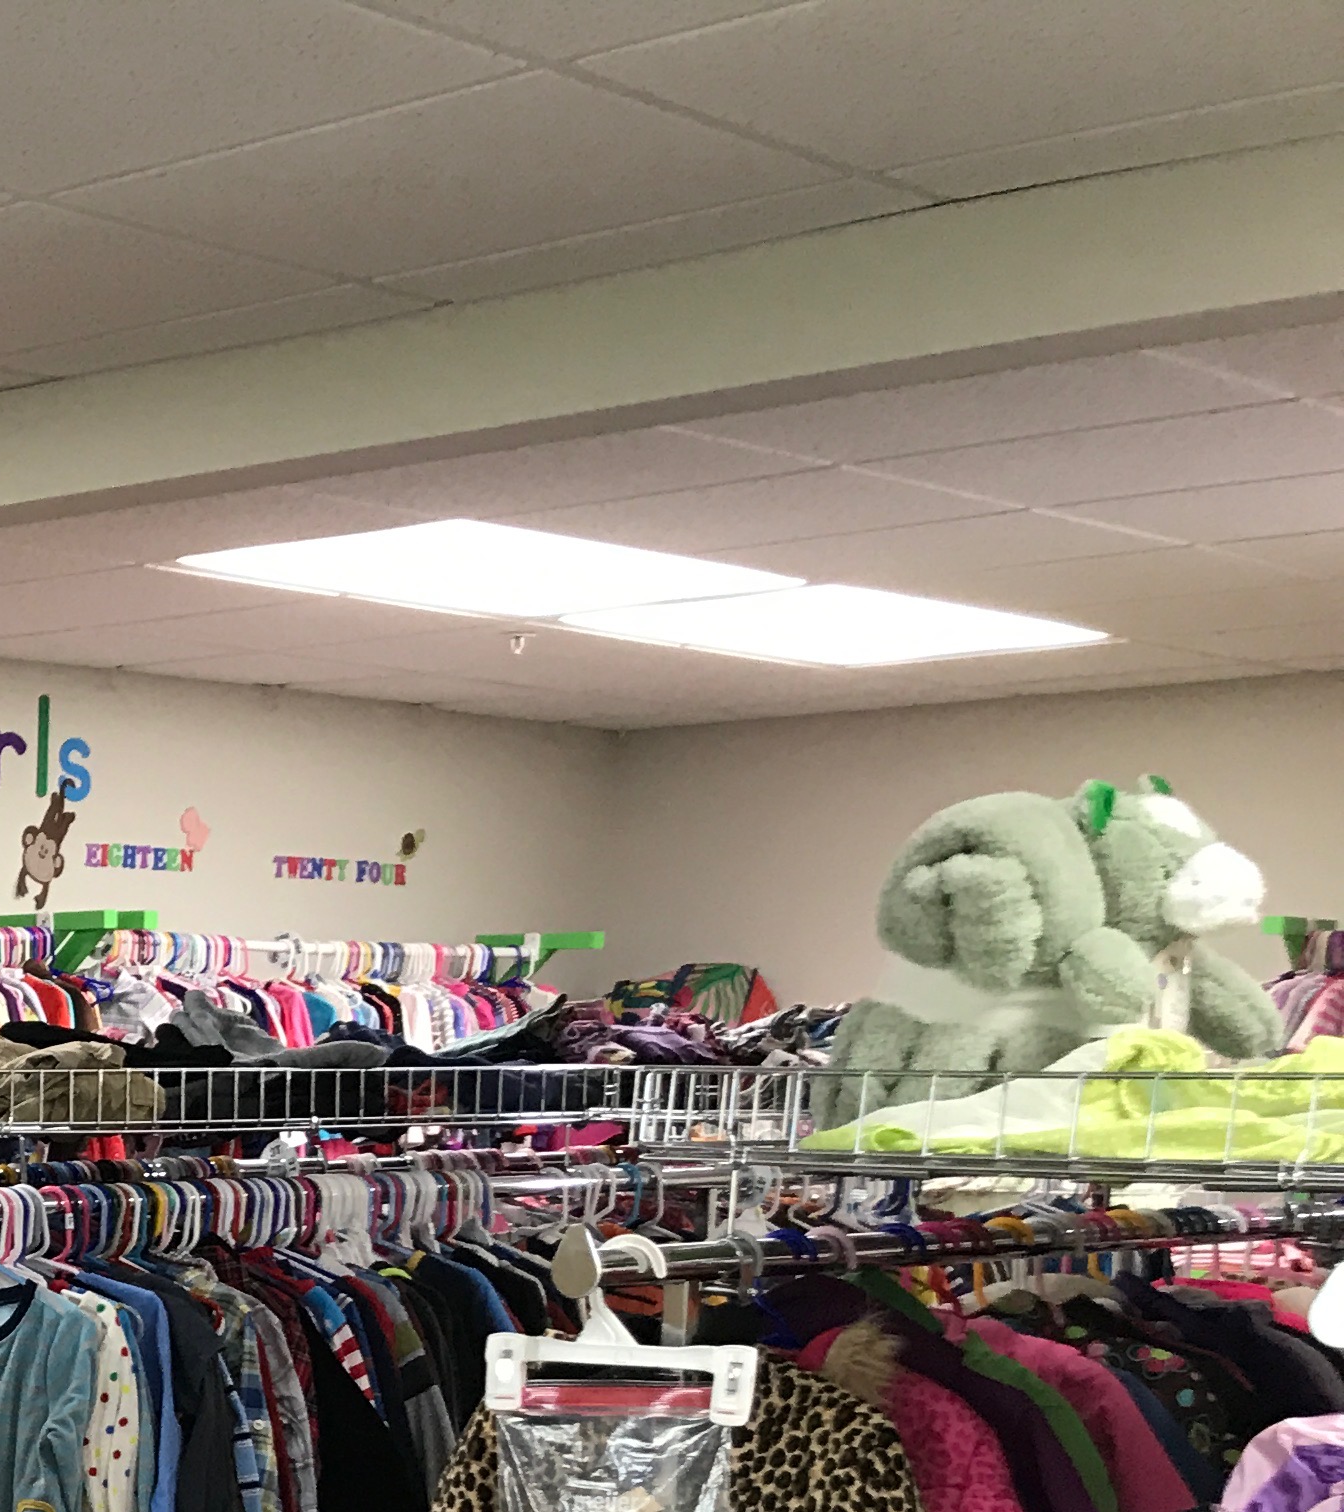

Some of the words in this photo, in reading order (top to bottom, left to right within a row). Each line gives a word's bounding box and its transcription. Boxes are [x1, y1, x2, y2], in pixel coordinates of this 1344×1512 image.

[85, 843, 195, 872] EIGHTEEN
[272, 855, 349, 881] TWENTY
[355, 860, 406, 886] FOUR
